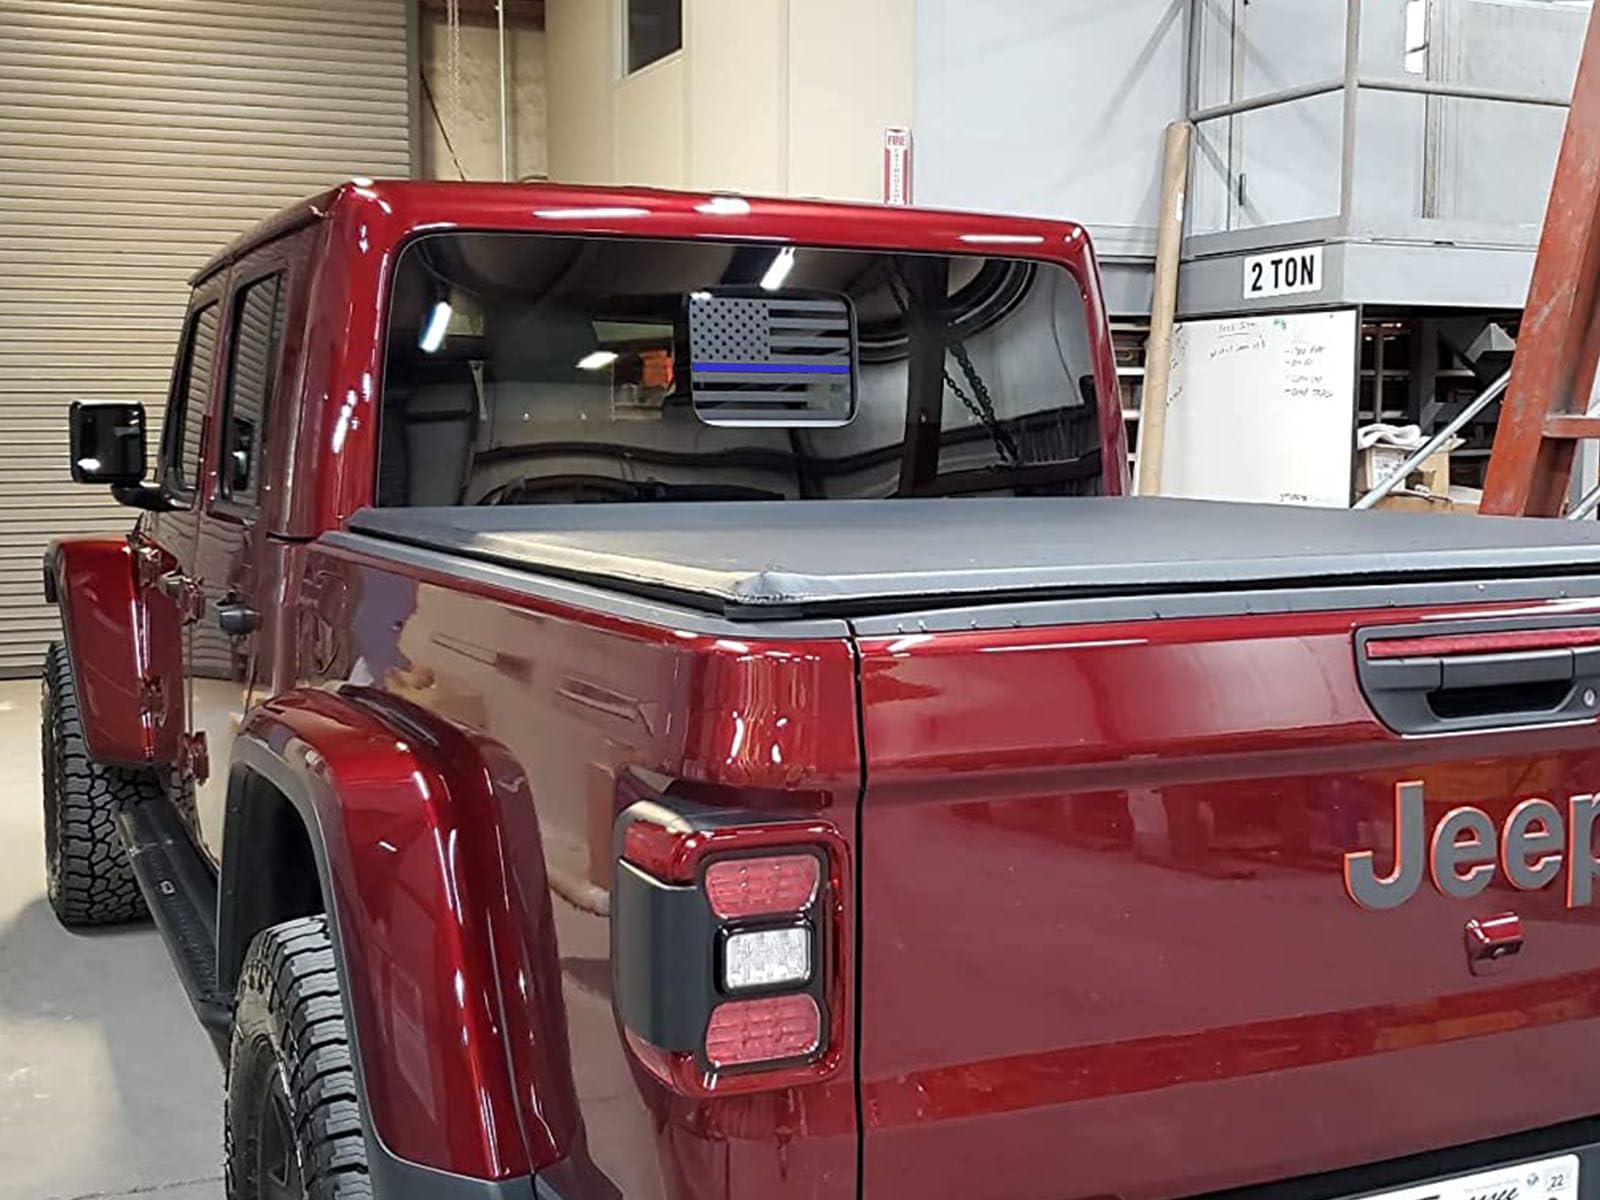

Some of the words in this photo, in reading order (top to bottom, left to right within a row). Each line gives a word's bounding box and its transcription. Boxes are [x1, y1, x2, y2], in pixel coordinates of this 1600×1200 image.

[887, 135, 905, 146] FIRE
[1251, 261, 1263, 292] 2
[1270, 253, 1315, 289] TON
[1550, 1173, 1565, 1188] 22
